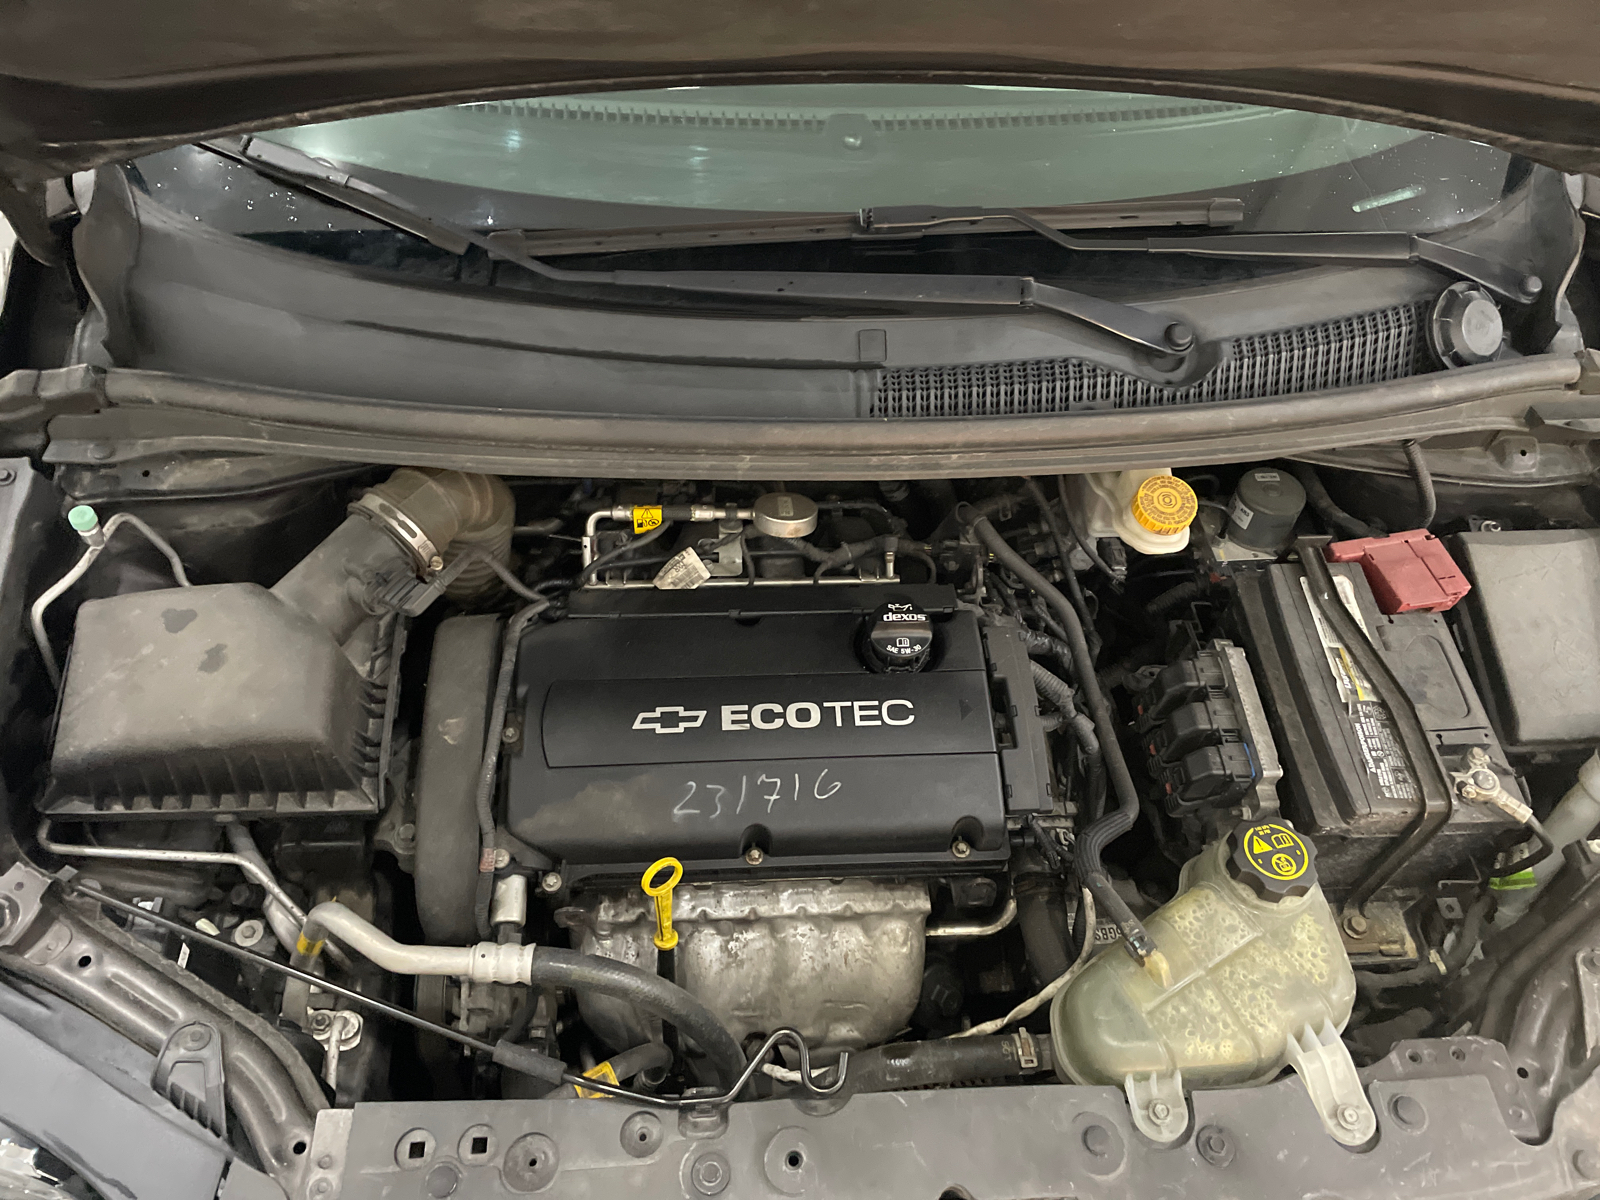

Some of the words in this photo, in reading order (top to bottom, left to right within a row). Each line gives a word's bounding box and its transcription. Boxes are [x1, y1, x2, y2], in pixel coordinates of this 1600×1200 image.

[883, 612, 927, 622] dexos
[886, 645, 898, 654] SAE
[901, 644, 922, 654] 5W-30
[721, 699, 915, 731] ECOTEC
[673, 769, 842, 819] 231716
